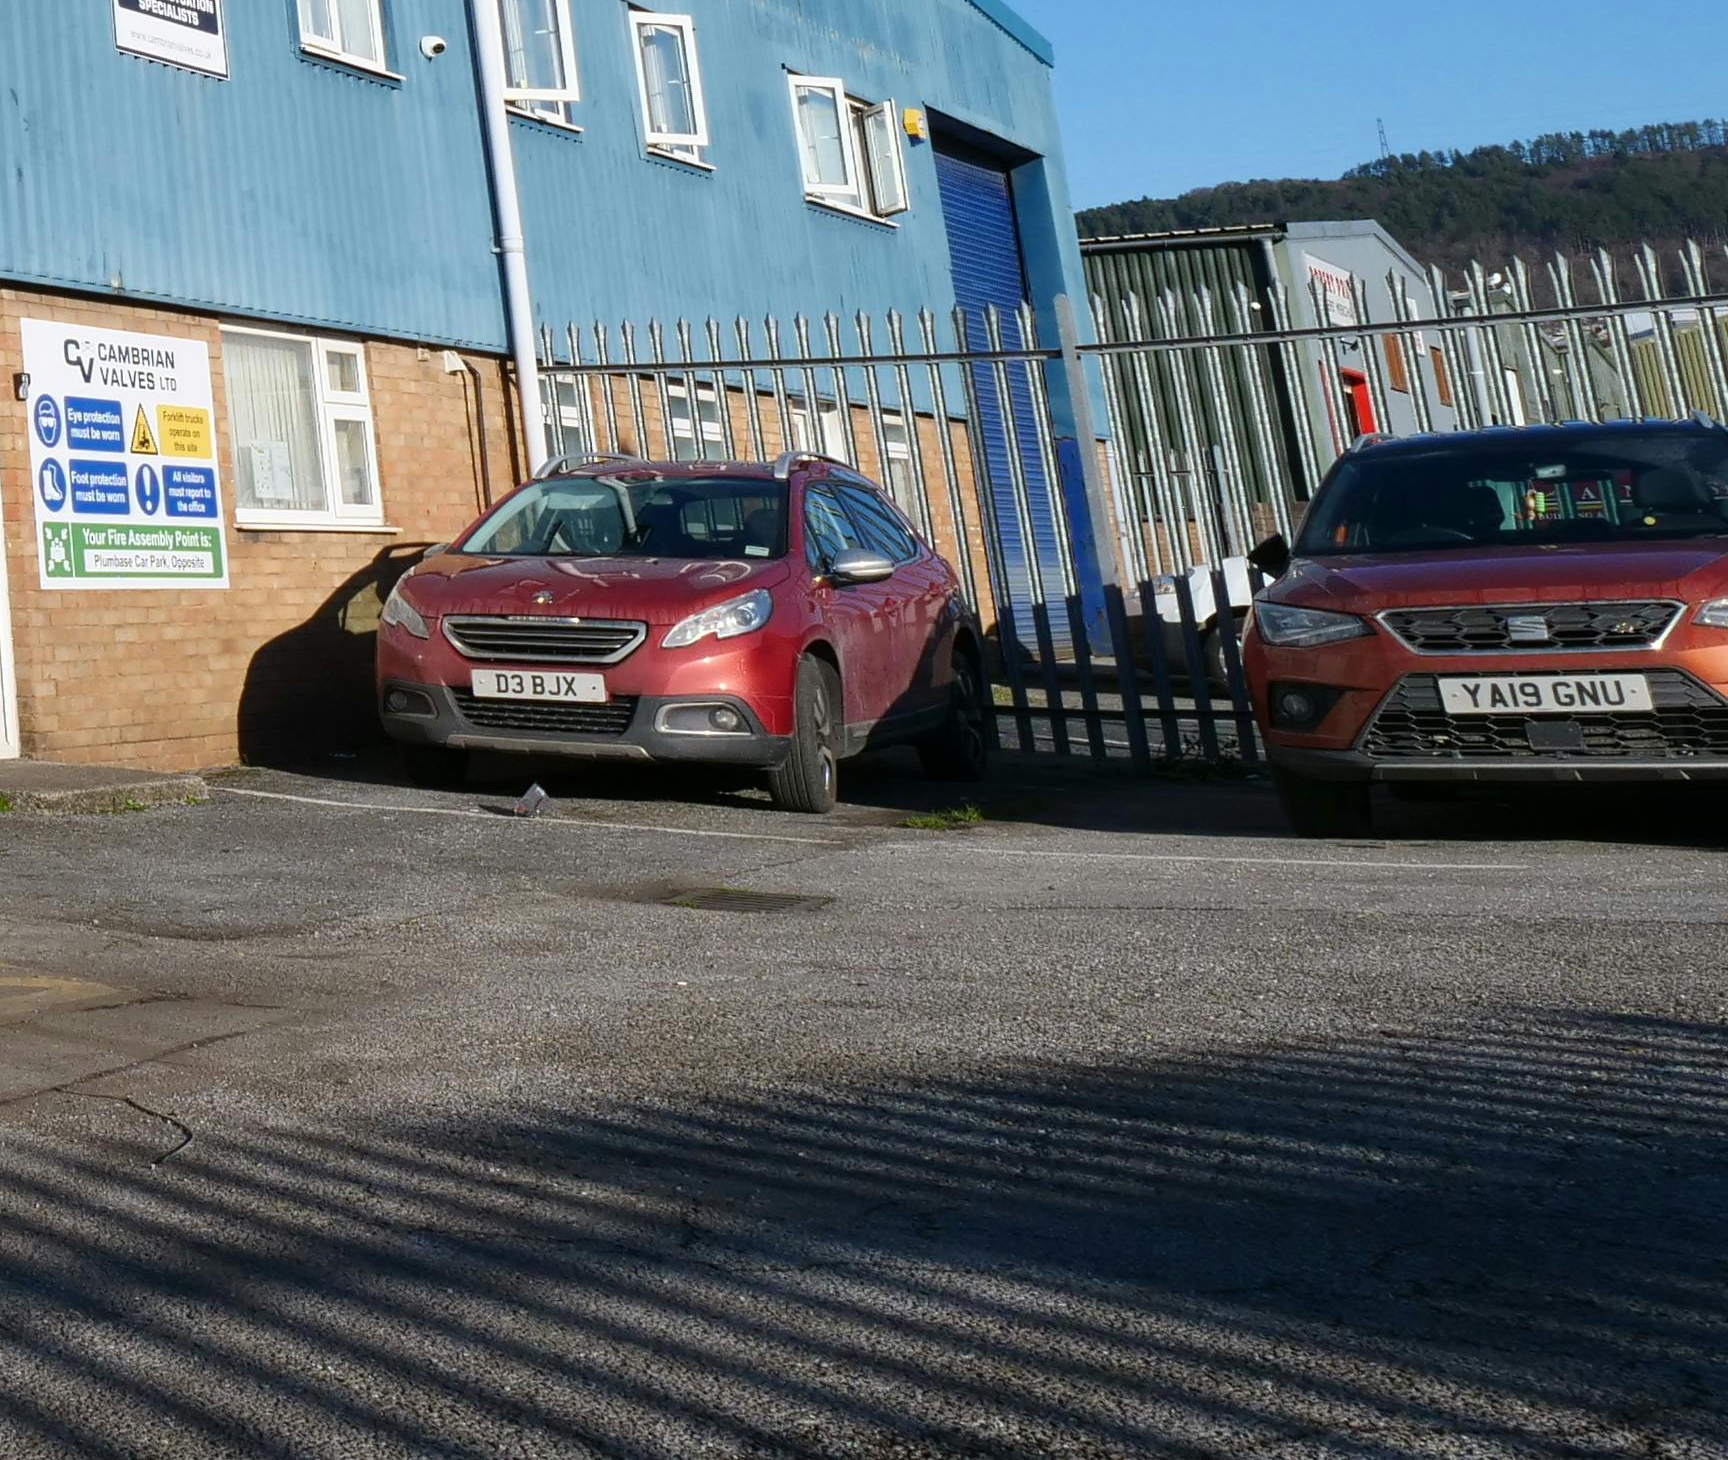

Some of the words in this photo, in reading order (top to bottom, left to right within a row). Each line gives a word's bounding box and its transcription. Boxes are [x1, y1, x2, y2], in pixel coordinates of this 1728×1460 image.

[97, 343, 175, 369] CAMBRIAN
[99, 367, 155, 390] VALVES
[159, 376, 177, 391] LTD
[67, 408, 83, 423] Eye
[83, 411, 120, 425] protection
[163, 411, 184, 424] Forklift
[184, 412, 204, 425] trucks
[70, 428, 90, 439] must
[91, 428, 101, 440] be
[101, 431, 120, 441] worn
[169, 428, 191, 440] operate
[191, 430, 200, 439] on
[174, 442, 185, 452] this
[185, 443, 198, 452] site
[71, 471, 89, 484] Foot
[89, 473, 128, 487] protection
[172, 471, 182, 482] All
[182, 473, 205, 484] visitors
[75, 491, 95, 501] must
[95, 491, 106, 502] be
[106, 493, 126, 503] worn
[169, 486, 185, 496] must
[185, 487, 204, 499] report
[205, 488, 212, 497] to
[177, 501, 188, 511] the
[188, 502, 206, 512] office
[82, 528, 107, 545] Your
[107, 529, 127, 545] Fire
[128, 529, 174, 550] Assembly
[175, 531, 199, 547] Point
[200, 532, 212, 547] is:
[94, 554, 133, 568] Plumbase
[134, 555, 149, 568] Car
[150, 555, 169, 569] Park,
[171, 556, 205, 571] Opposite
[495, 673, 524, 694] D3
[531, 675, 577, 696] BJX
[1460, 681, 1541, 709] YA19
[1552, 679, 1625, 707] GNU
